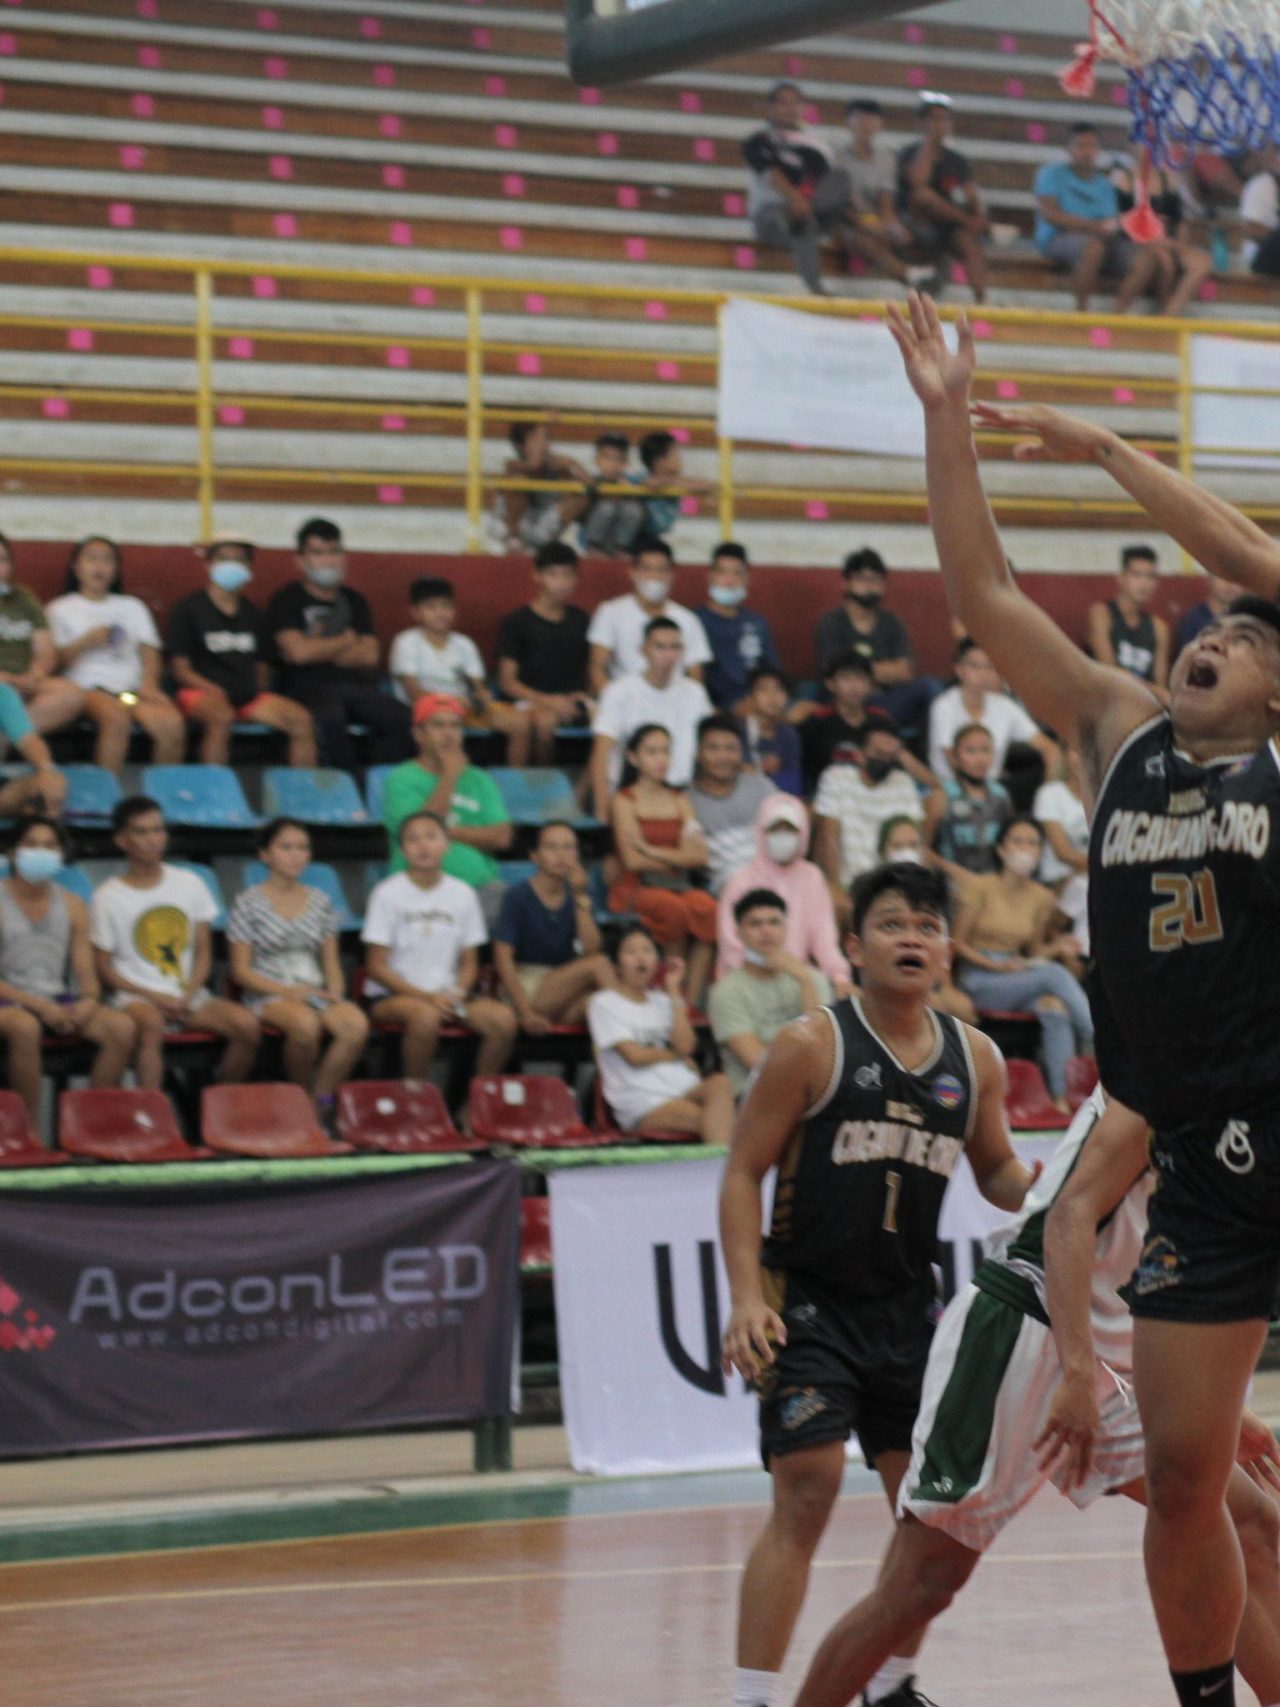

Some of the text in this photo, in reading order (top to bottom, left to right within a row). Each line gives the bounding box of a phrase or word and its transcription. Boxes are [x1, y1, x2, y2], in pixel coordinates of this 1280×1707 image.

[1149, 867, 1223, 951] 20
[882, 1170, 902, 1233] 1
[69, 1244, 487, 1325] AdconLED
